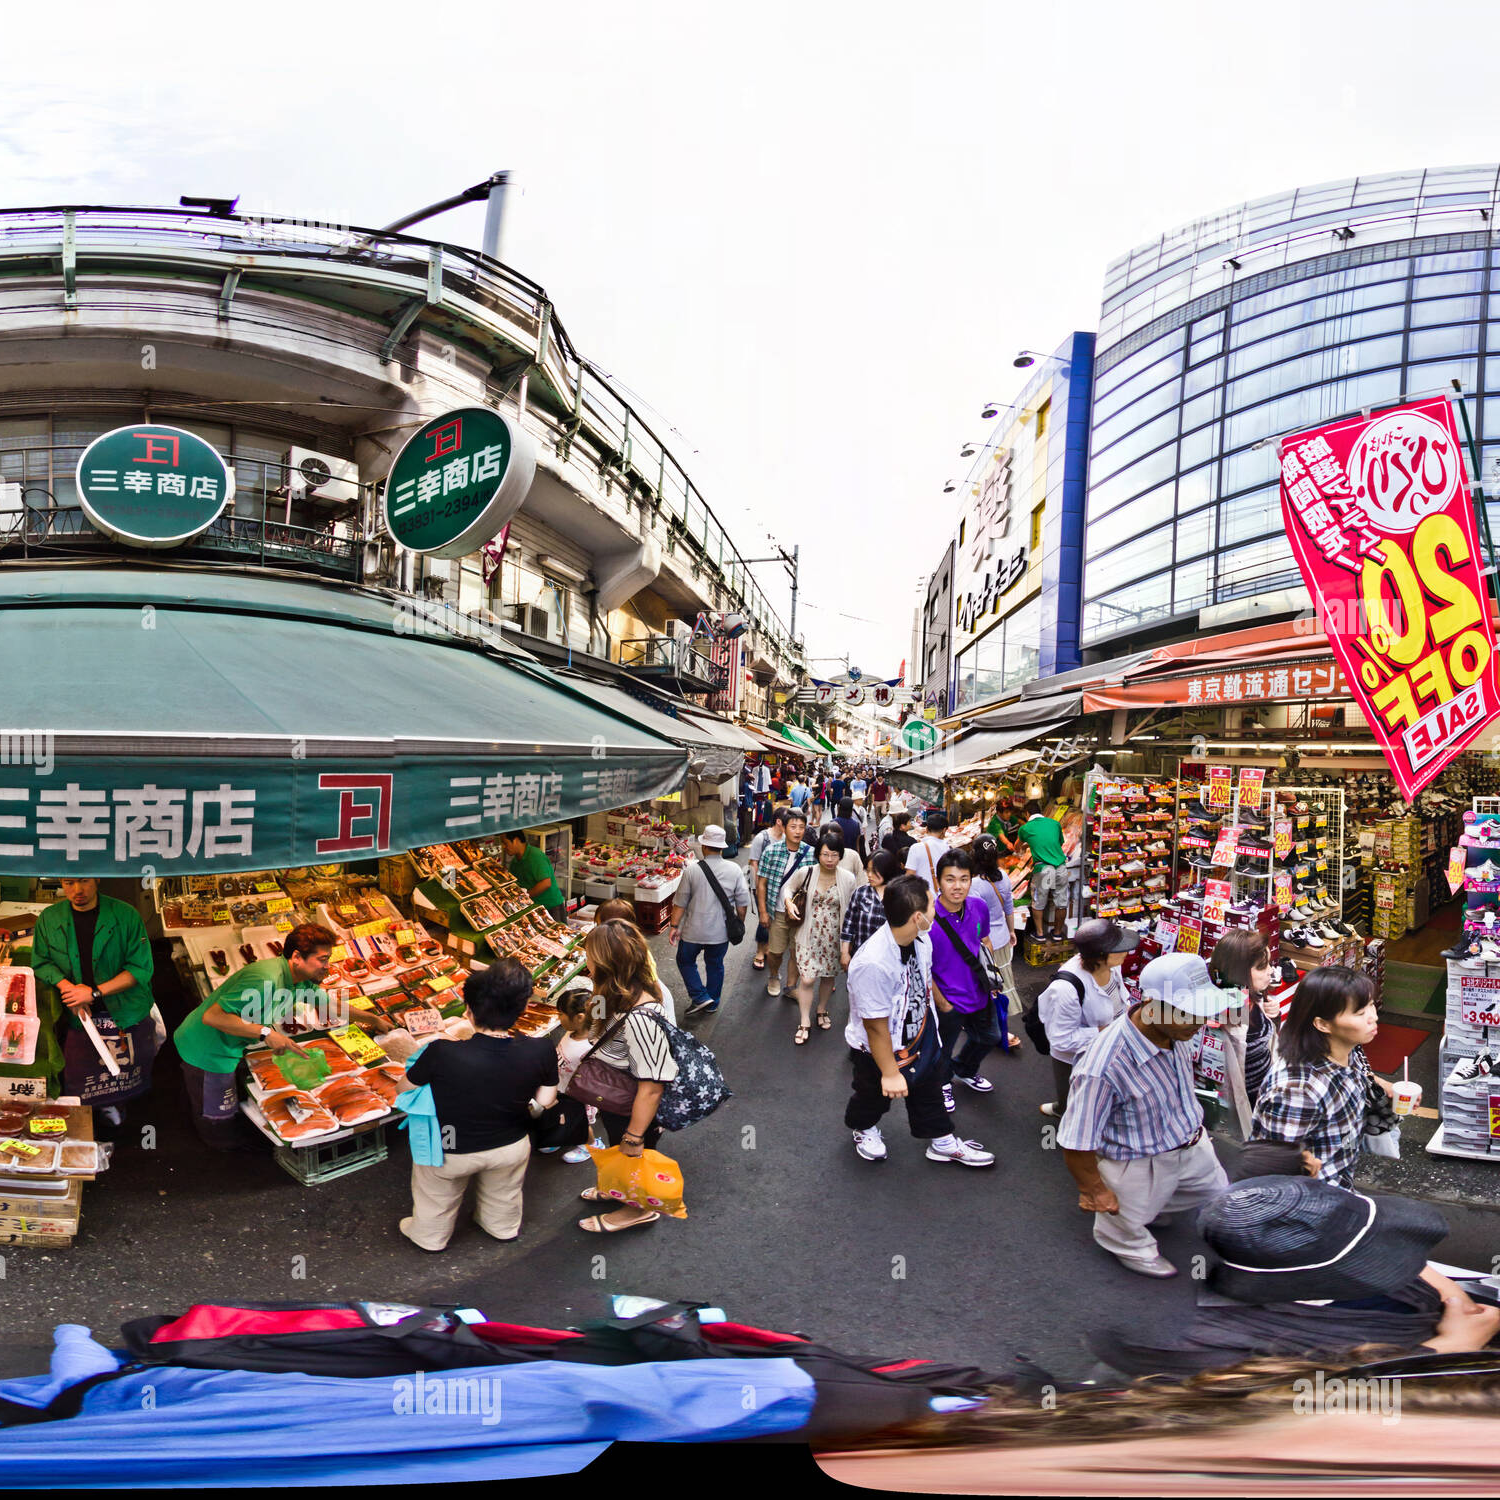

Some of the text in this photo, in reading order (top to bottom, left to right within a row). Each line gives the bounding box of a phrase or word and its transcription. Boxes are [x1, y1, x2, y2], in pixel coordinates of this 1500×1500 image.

[89, 469, 218, 500] 三幸商店
[394, 444, 502, 517] 三幸商店
[819, 686, 890, 702] アメ横
[444, 771, 564, 829] 三幸商店
